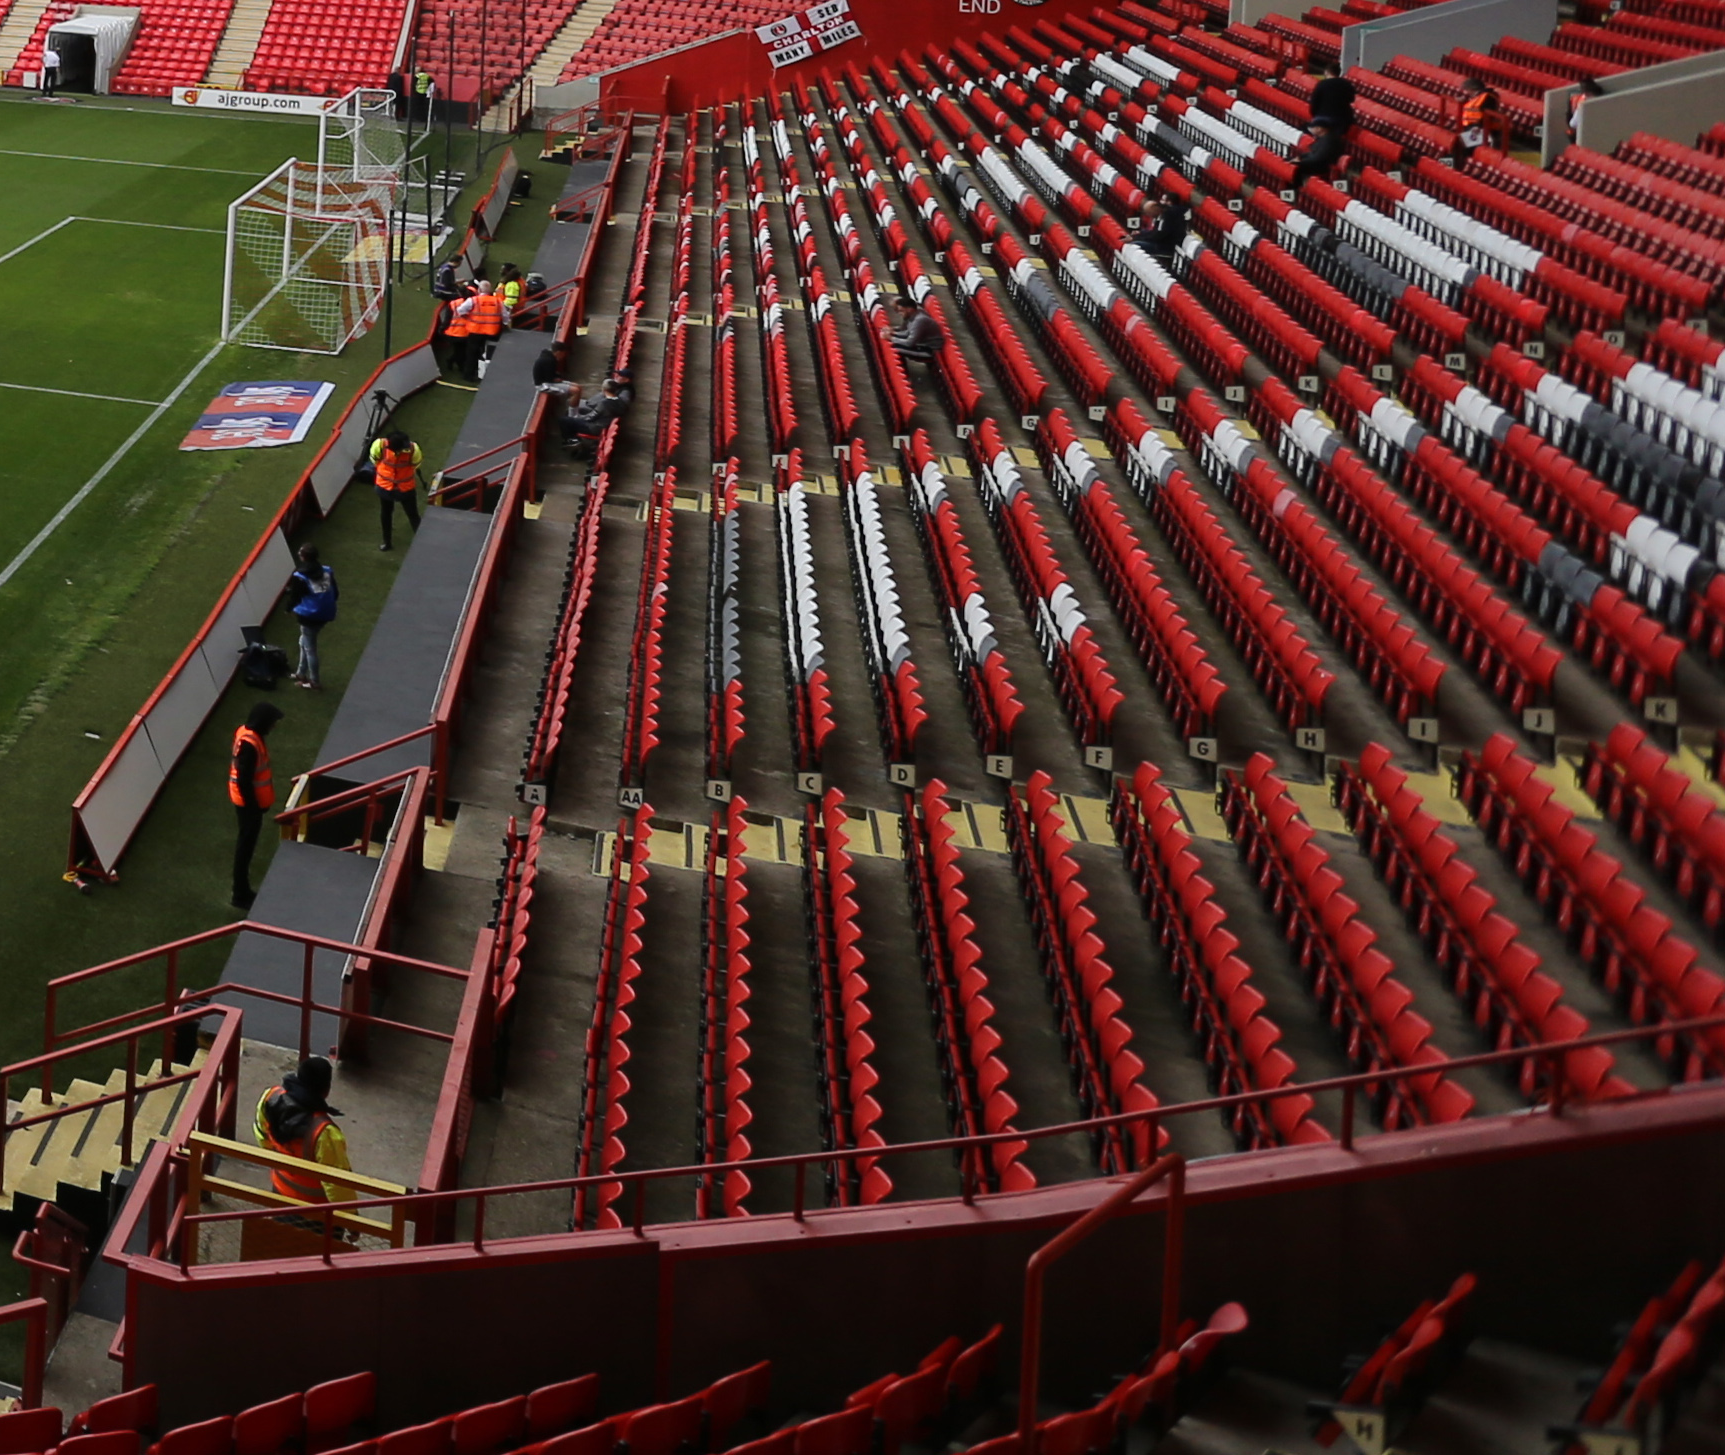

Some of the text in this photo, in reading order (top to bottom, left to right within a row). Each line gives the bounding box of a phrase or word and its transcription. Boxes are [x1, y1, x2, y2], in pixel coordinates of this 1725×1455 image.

[773, 15, 844, 49] CHARLTON
[775, 24, 856, 64] MANY MILES
[217, 92, 301, 111] ajgroup.com
[1450, 357, 1461, 366] M
[1655, 702, 1667, 717] K
[1535, 714, 1542, 728] J
[1304, 732, 1316, 746] H
[1197, 742, 1209, 755] G
[1095, 751, 1103, 763] F
[996, 760, 1003, 773] E
[898, 768, 908, 781] D
[714, 783, 724, 797] B
[805, 776, 814, 790] C
[530, 787, 540, 801] A
[621, 789, 641, 804] AA
